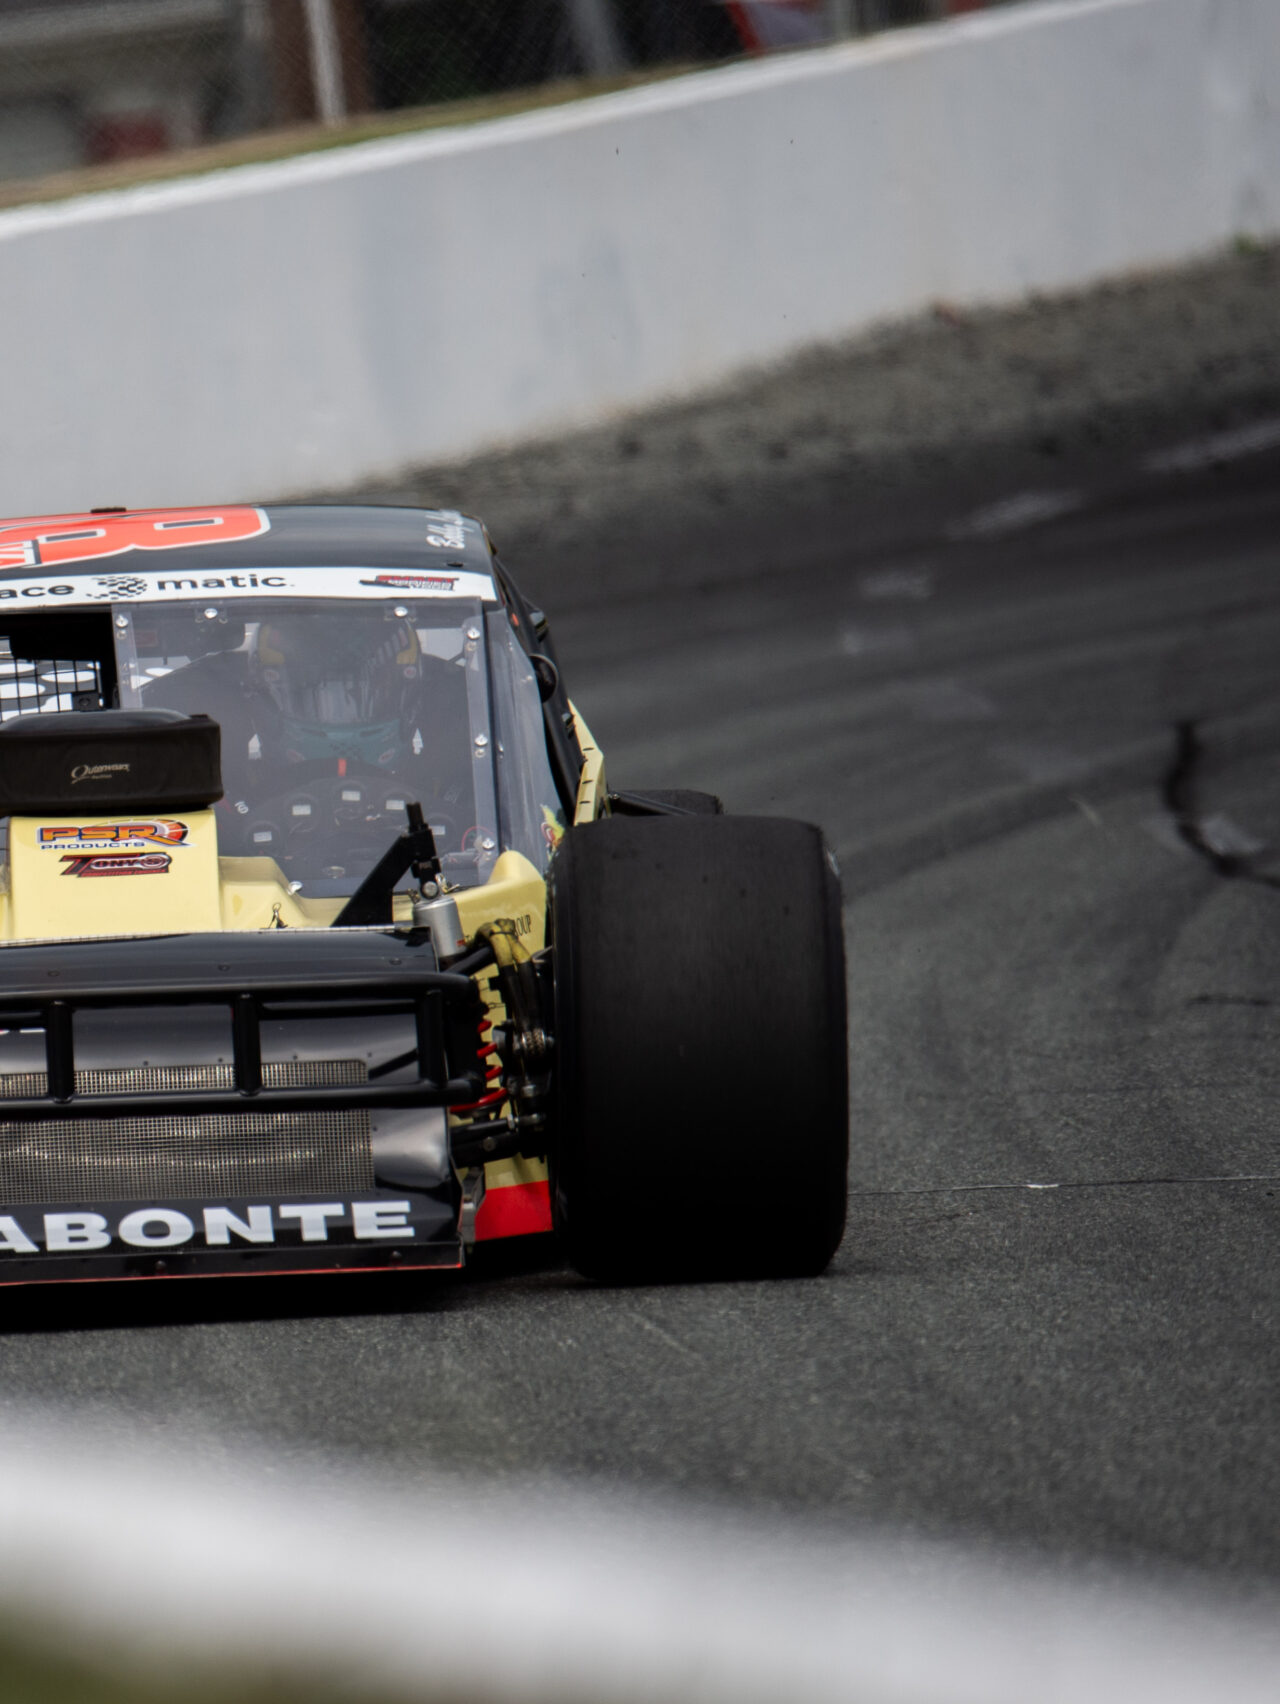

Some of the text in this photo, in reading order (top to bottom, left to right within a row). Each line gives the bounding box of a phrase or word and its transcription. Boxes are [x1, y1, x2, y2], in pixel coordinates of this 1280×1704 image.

[157, 574, 287, 591] matic
[39, 825, 190, 847] PSR
[40, 841, 146, 850] PRODUCTS
